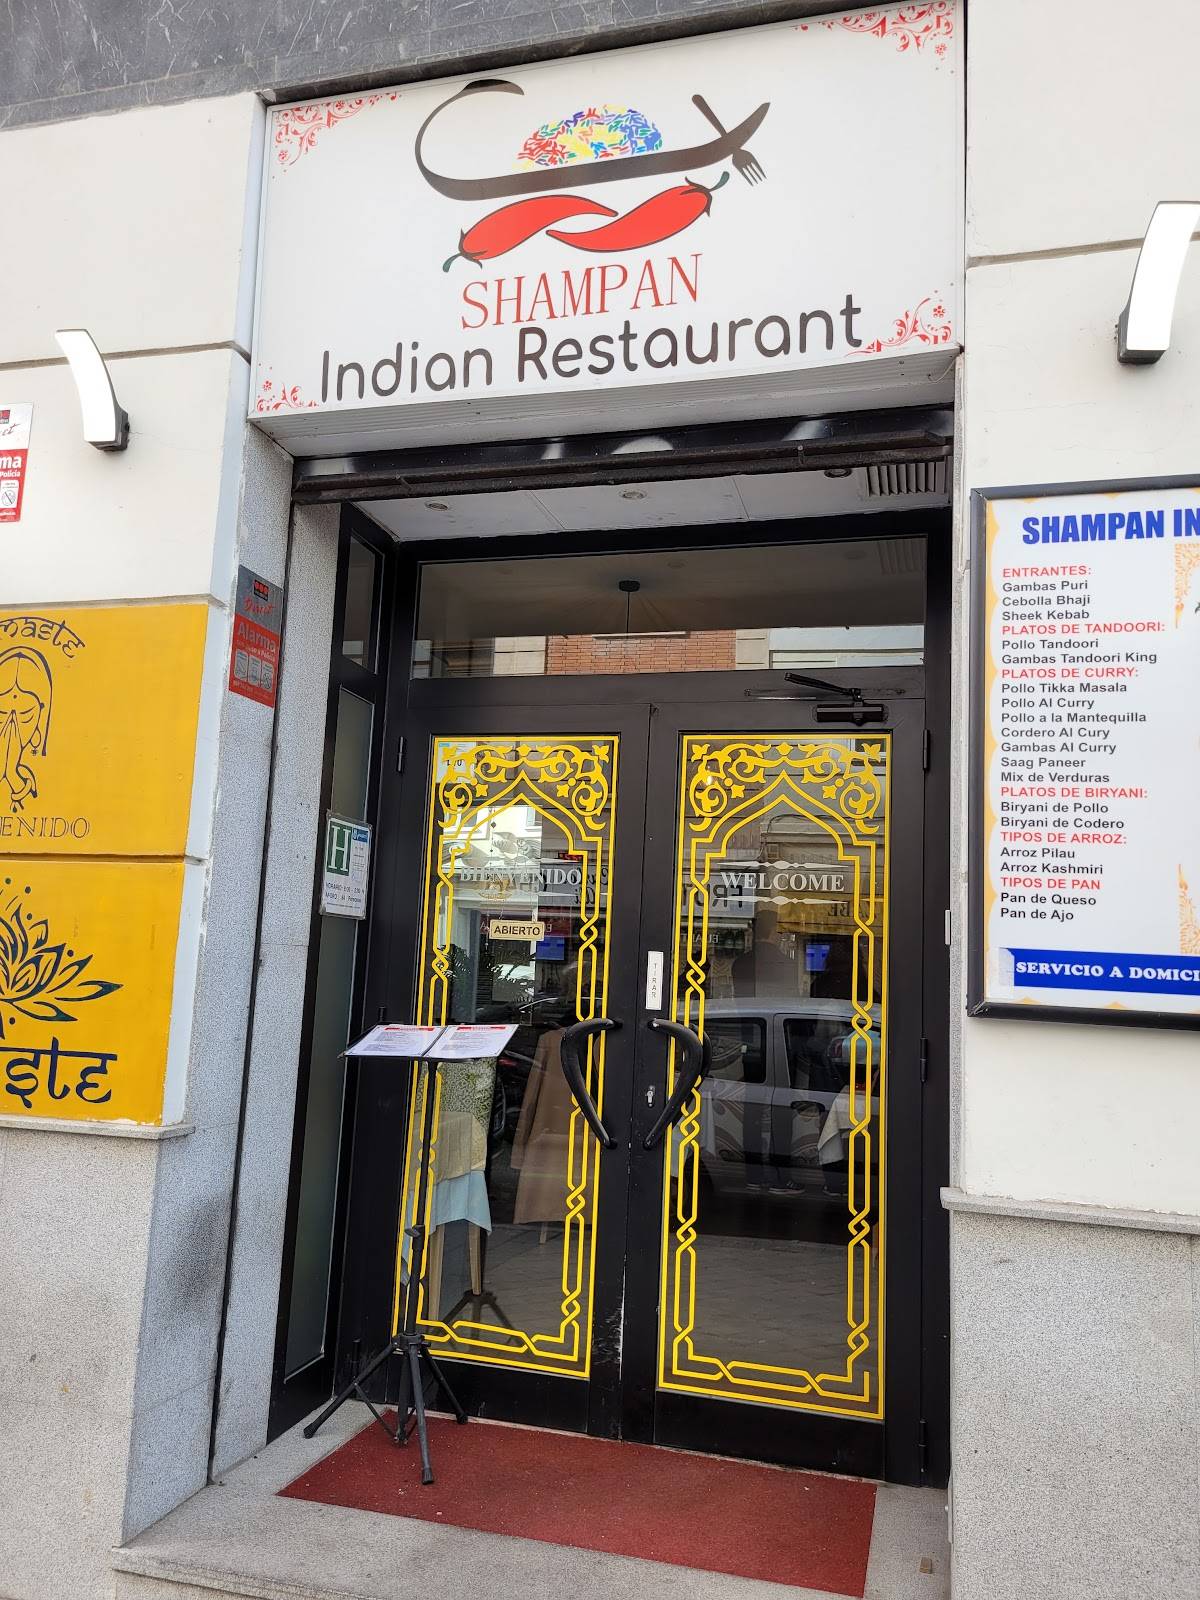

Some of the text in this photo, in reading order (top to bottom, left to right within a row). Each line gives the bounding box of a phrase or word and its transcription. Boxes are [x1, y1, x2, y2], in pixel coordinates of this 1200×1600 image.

[462, 253, 703, 329] SHAMPAN
[322, 294, 863, 402] Indian Restaurant
[1022, 508, 1200, 544] SHAMPAN IN
[1003, 565, 1092, 578] ENTRANTES:
[1003, 581, 1088, 592] Gambas Puri
[1003, 595, 1091, 607] Cebolla Bhaji
[1002, 610, 1090, 621] Sheek Kebab
[1002, 622, 1165, 635] PLATOS DE TANDOORI:
[1002, 639, 1099, 650] Pollo Tandoori
[1002, 653, 1157, 664] Gambas Tandoori King
[1002, 667, 1138, 678] PLATOS DE CURRY:
[1001, 683, 1127, 694] Pollo Tikka Masala
[1001, 698, 1095, 710] Pollo Al Curry
[1001, 713, 1034, 723] Pollo
[1052, 713, 1062, 722] la
[1067, 713, 1146, 724] Mantequilla
[1001, 728, 1110, 739] Cordero Al Cury
[1001, 743, 1117, 755] Gambas Al Curry
[1001, 757, 1086, 769] Saag Paneer
[1001, 772, 1110, 783] Mix de Verduras
[1001, 787, 1148, 798] PLATOS DE BIRYANI:
[1000, 802, 1109, 815] Biryani de Pollo
[1000, 817, 1125, 830] Biryani de Codero
[1000, 832, 1127, 844] TIPOS DE ARROZ:
[328, 825, 351, 871] H
[1000, 847, 1075, 858] Arroz Pilau
[1000, 862, 1103, 875] Arroz Kashmiri
[459, 868, 582, 886] BIENVENIDO
[720, 872, 845, 892] WELCOME
[1000, 877, 1100, 890] TIPOS DE PAN
[1000, 893, 1096, 906] Pan de Queso
[1000, 908, 1074, 922] Pan de Ajo
[493, 926, 541, 936] ABIERTO
[1016, 962, 1200, 982] SERVICIO A DOMICI
